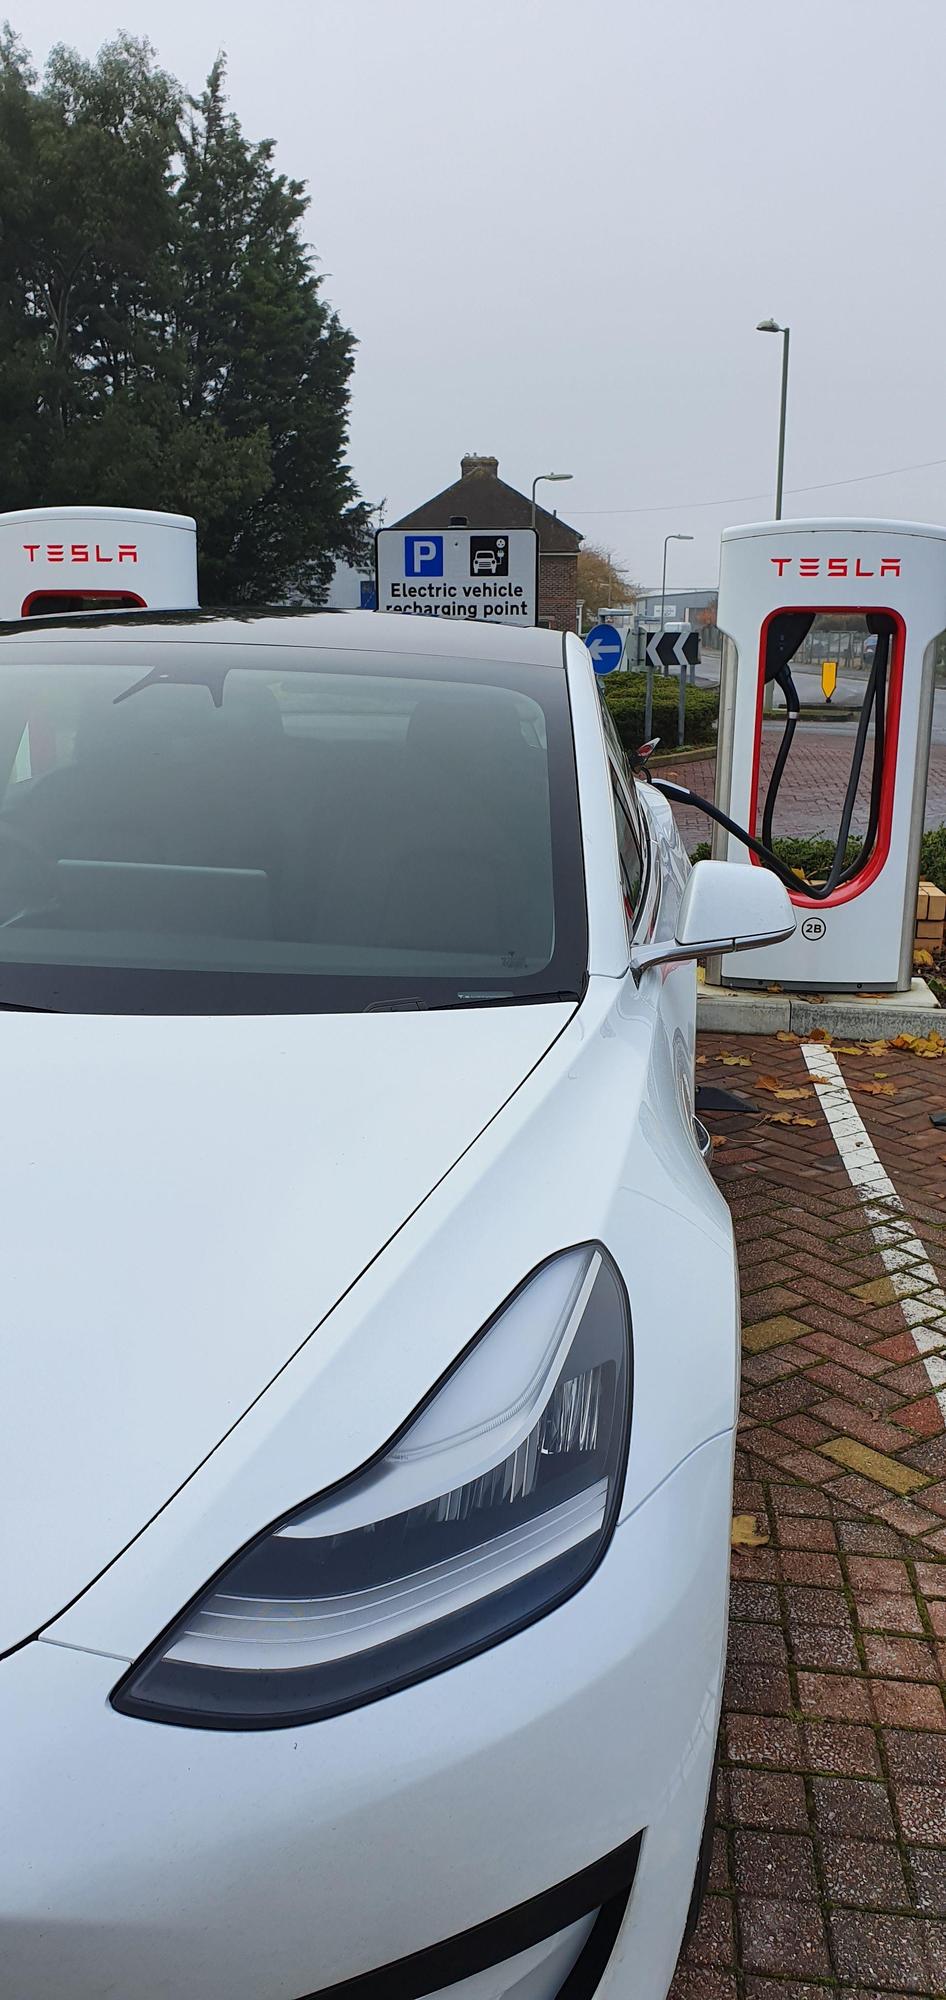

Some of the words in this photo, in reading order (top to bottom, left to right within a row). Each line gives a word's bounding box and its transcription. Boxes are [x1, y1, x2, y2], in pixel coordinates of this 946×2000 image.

[23, 545, 137, 562] TESLA
[413, 541, 437, 573] P
[770, 558, 901, 577] TESLA
[391, 583, 457, 597] Electric
[462, 582, 523, 597] vehicle
[483, 601, 528, 618] point
[805, 923, 822, 934] 2B
